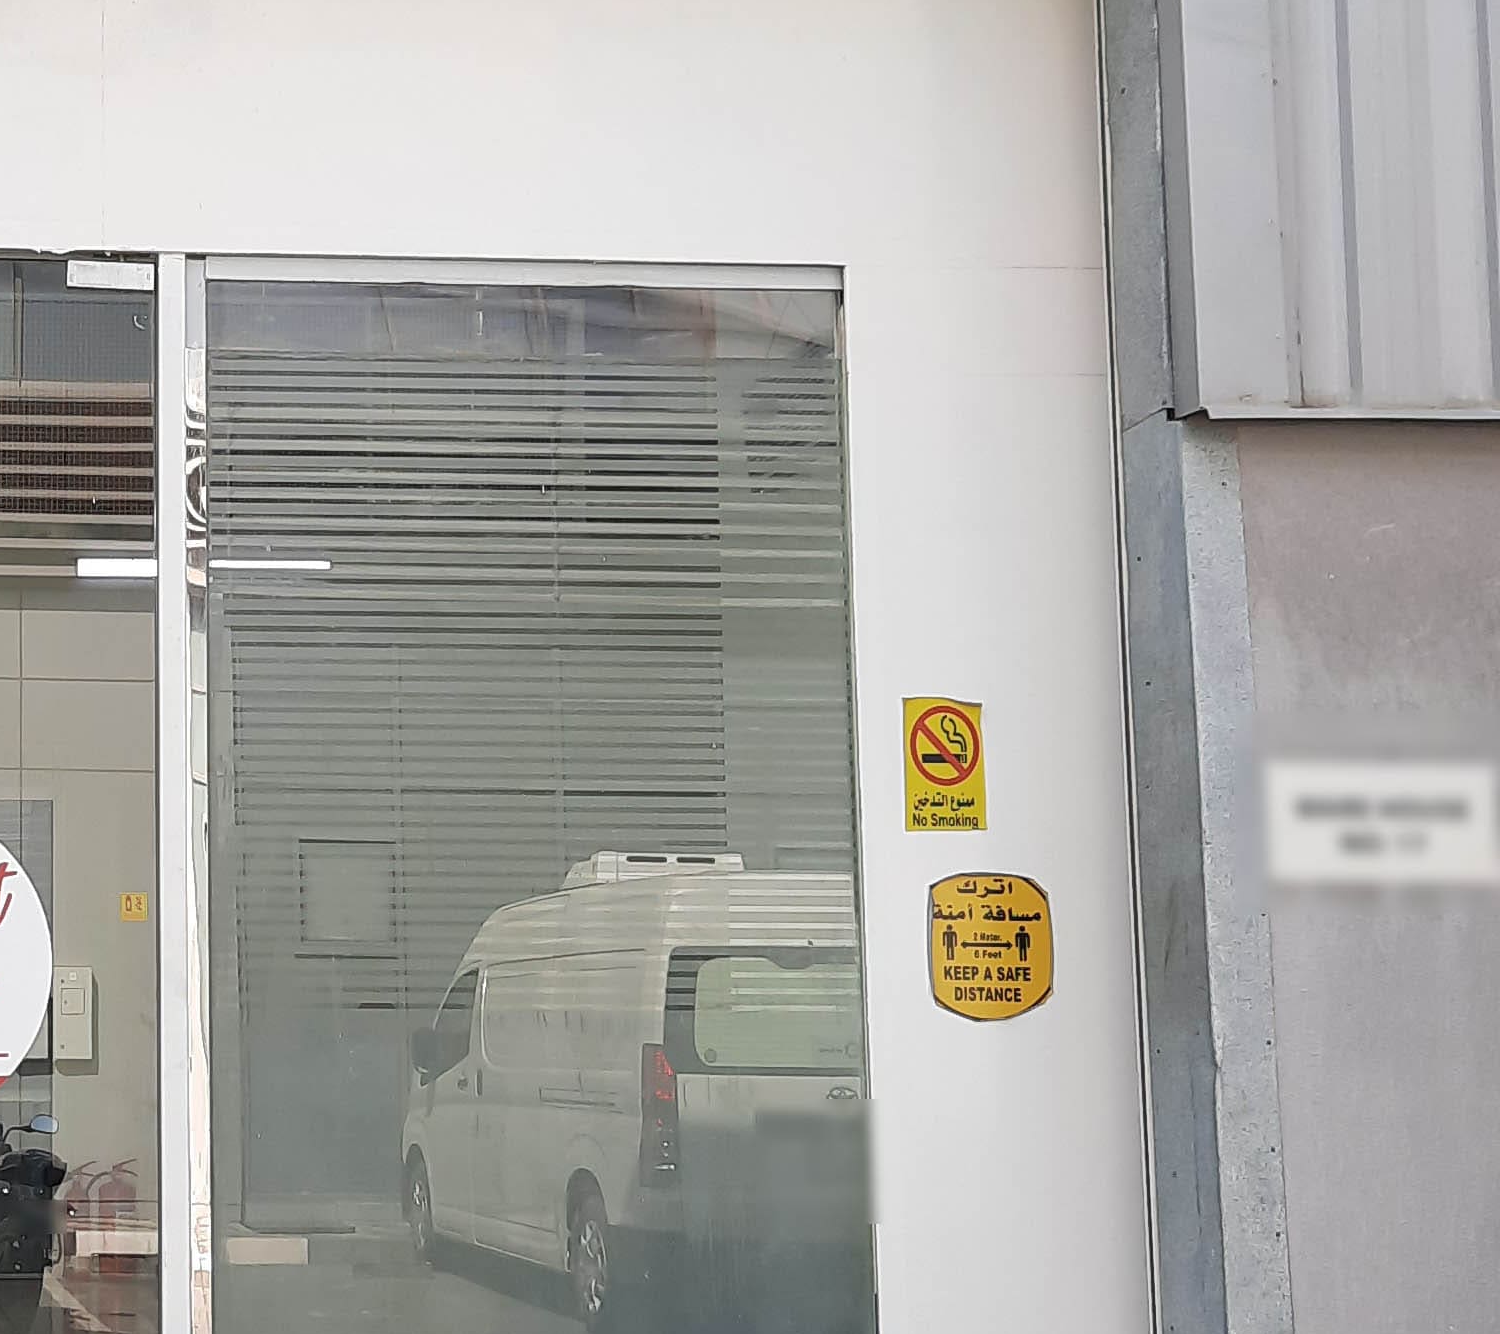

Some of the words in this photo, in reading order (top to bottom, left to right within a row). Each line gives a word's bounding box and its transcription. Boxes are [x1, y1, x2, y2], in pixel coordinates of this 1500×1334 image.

[950, 792, 975, 811] ممنوع
[912, 813, 927, 826] No
[931, 813, 979, 829] Smoking
[957, 879, 1013, 898] اترك
[944, 966, 979, 981] KEEP
[984, 967, 993, 981] A
[997, 967, 1031, 982] SAFE
[954, 986, 1022, 1002] DISTANCE
